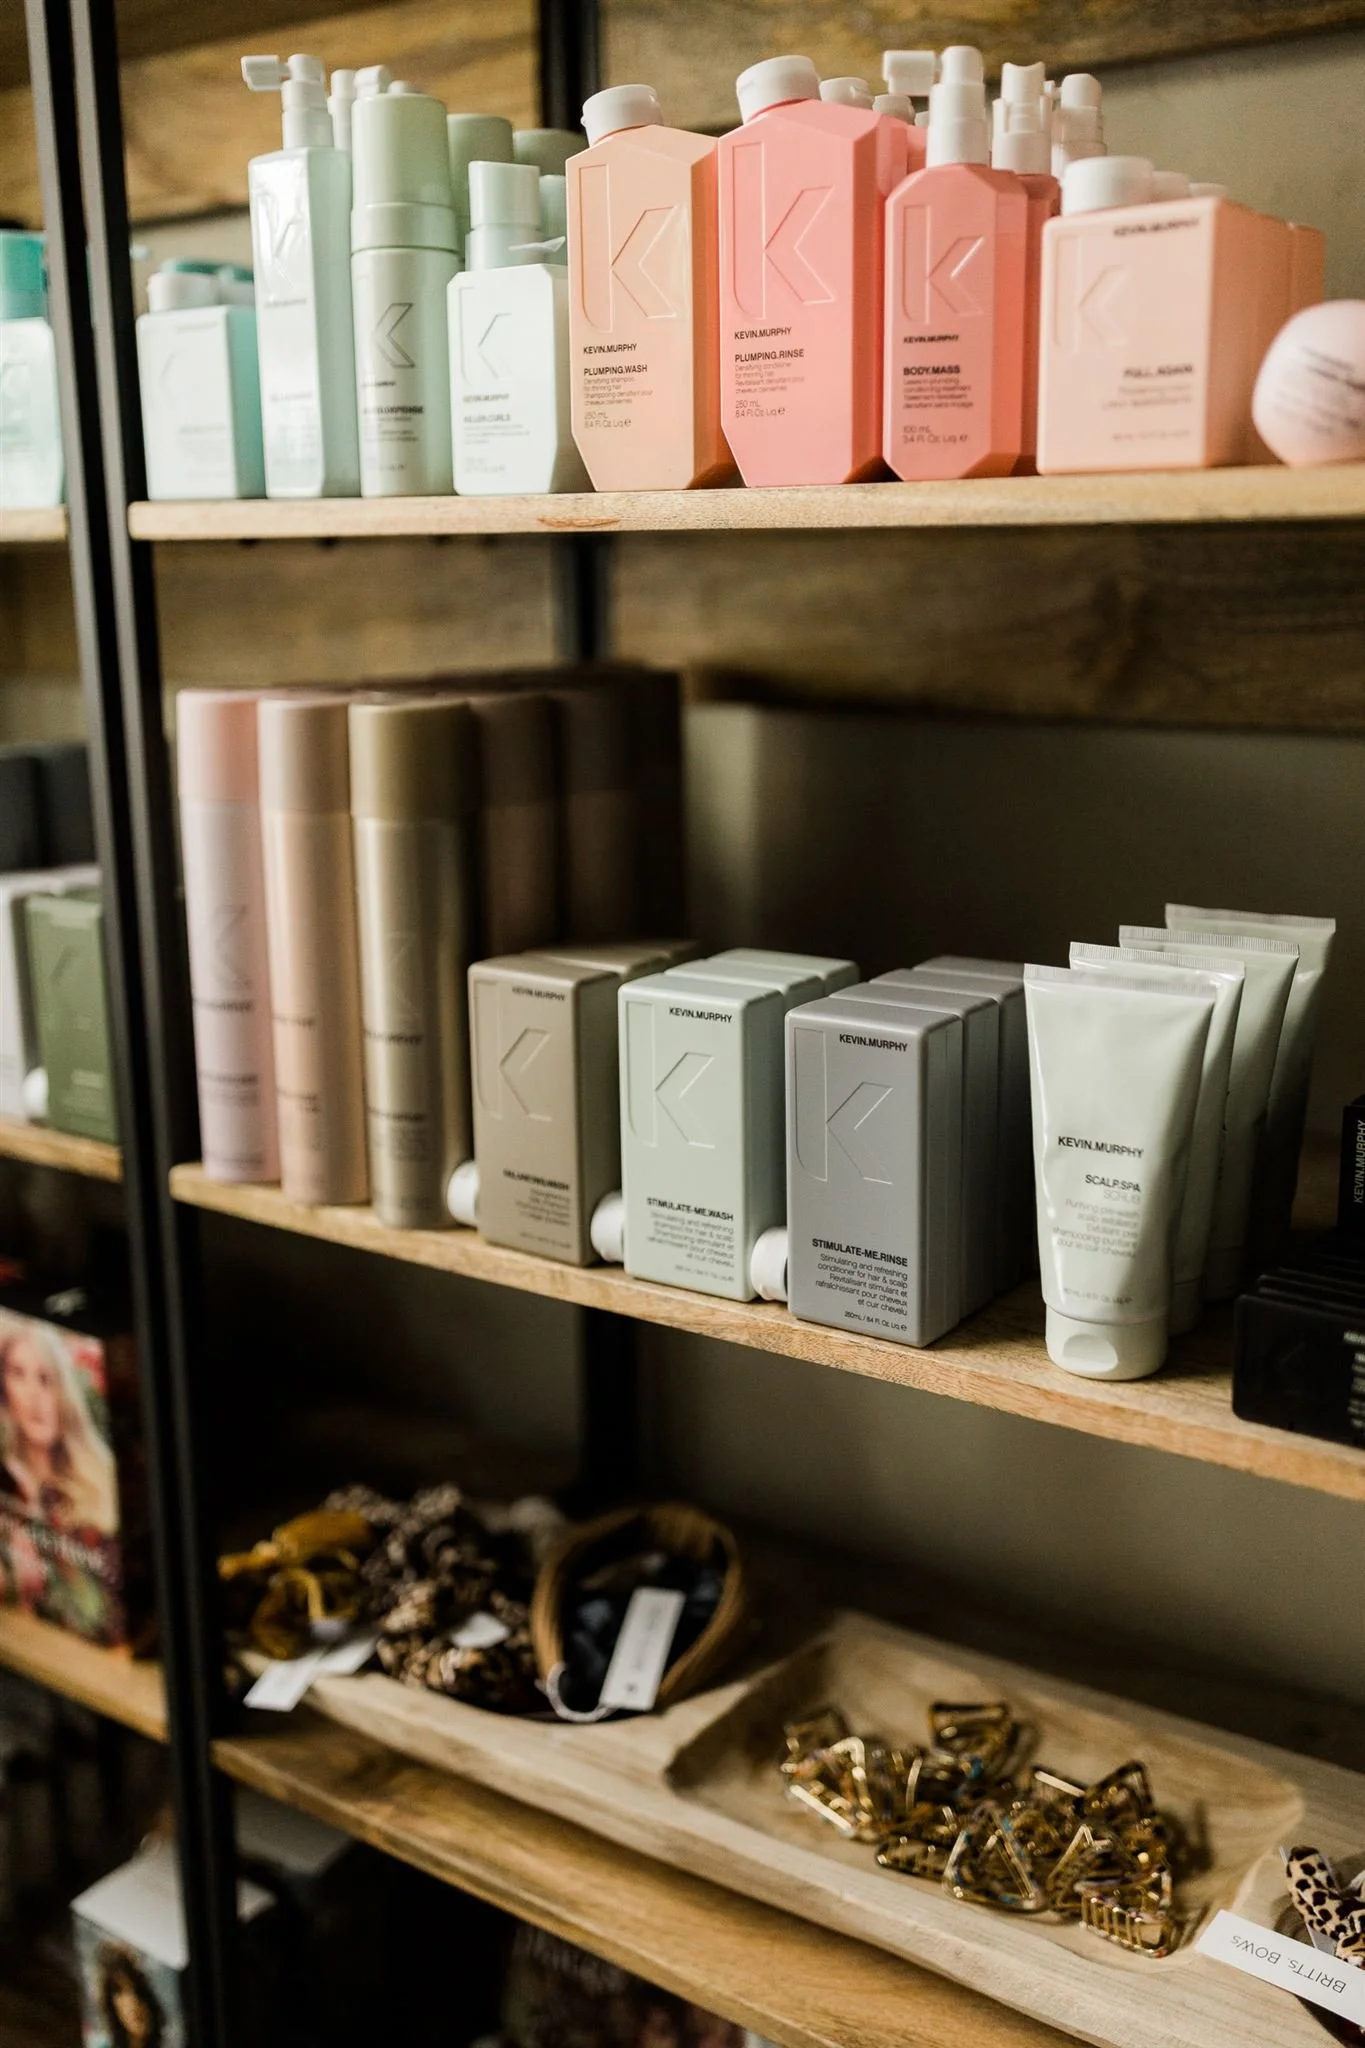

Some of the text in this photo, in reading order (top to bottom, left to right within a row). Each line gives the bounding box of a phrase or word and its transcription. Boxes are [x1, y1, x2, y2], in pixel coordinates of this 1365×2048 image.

[735, 326, 792, 340] KEVIN.MURPHY
[583, 343, 637, 354] KEVIN.MURPHY
[735, 348, 804, 362] PLUMPING.RINSE
[583, 364, 648, 376] PLUMPING.WASH
[903, 365, 961, 376] BODY.MASS
[669, 1007, 732, 1023] KEVIN.MURPHY
[839, 1033, 908, 1052] KEVIN.MURPHY
[1058, 1135, 1144, 1159] KEVIN.MURPHY
[1085, 1173, 1141, 1192] SCALP.SPA
[647, 1197, 734, 1221] STIMULATE-ME.WASH
[812, 1238, 908, 1267] STIMULATE-ME.RINSE
[817, 1262, 856, 1276] conditioner
[857, 1269, 866, 1278] for
[868, 1272, 881, 1281] hair
[889, 1278, 908, 1289] scalp
[820, 1253, 908, 1281] Stimulating and refreshing
[830, 1272, 907, 1297] Revitalisant stimulant et
[857, 1298, 907, 1316] et cuir chevelu
[862, 1290, 878, 1300] pour
[879, 1294, 907, 1307] cheveux
